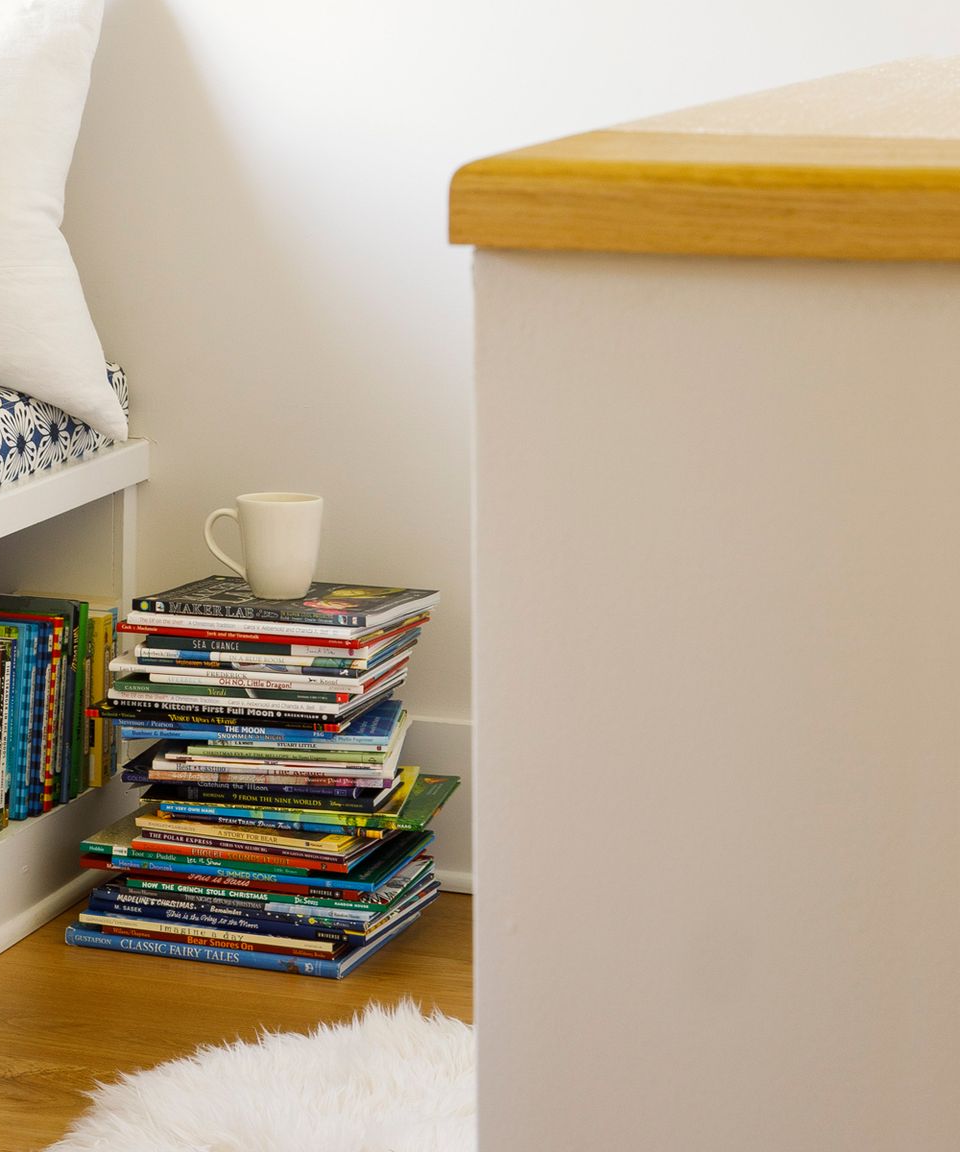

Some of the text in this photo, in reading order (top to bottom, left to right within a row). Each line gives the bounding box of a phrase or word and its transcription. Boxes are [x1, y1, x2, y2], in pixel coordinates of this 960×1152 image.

[169, 602, 222, 617] MAKER
[225, 606, 254, 618] LAB
[193, 640, 239, 650] SEA CHANGE
[207, 671, 248, 679] FREDERICK
[266, 681, 292, 689] Dragon!
[120, 700, 151, 708] HENKES
[162, 702, 274, 717] Kitten's First Full Moon
[242, 726, 265, 734] MOON
[274, 797, 291, 805] NINE
[163, 833, 184, 841] POLAR
[185, 836, 213, 845] EXPRESS
[223, 831, 244, 839] STORY
[246, 833, 259, 841] FOR
[156, 852, 177, 861] Puddle
[217, 869, 277, 882] SUMMER SONG
[177, 885, 203, 894] GRINCH
[206, 889, 226, 897] STOLE
[229, 890, 268, 900] CHRISTMAS
[74, 935, 112, 945] GUSTAFSON
[187, 936, 254, 950] Bear Snores On
[120, 939, 240, 963] CLASSIC FAIRY TALES
